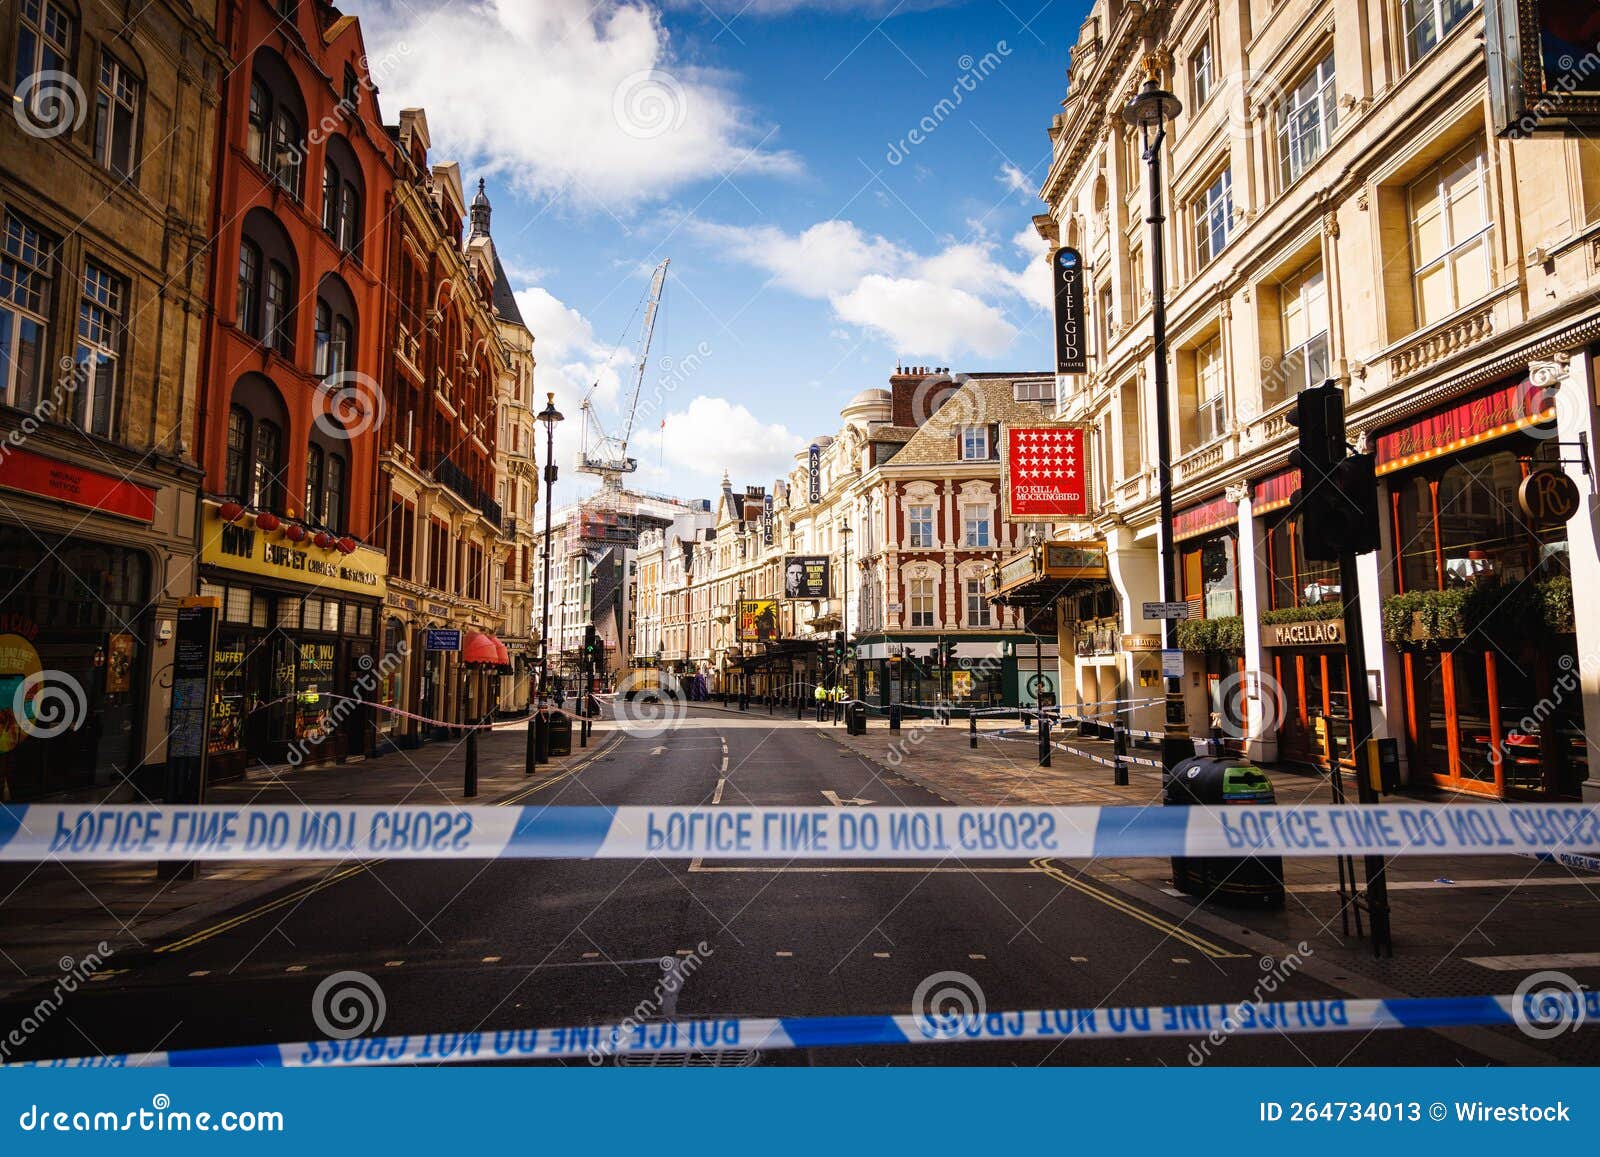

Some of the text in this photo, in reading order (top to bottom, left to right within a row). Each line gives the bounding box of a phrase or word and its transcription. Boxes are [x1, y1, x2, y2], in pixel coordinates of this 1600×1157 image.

[1062, 269, 1078, 360] GIELGUD
[810, 452, 819, 501] APOLLO
[1016, 485, 1060, 493] TO KILL A
[1016, 493, 1080, 501] MOCKINGBIRD
[765, 503, 773, 541] LYRIC
[264, 542, 308, 571] BUFFET
[1275, 623, 1337, 643] MACELLAIO
[215, 651, 244, 663] BUFFET
[301, 644, 334, 660] MR WU
[313, 661, 334, 670] BUFFET
[1560, 853, 1584, 866] POLICE
[1037, 1008, 1097, 1035] NOT
[421, 1031, 480, 1059] NOT
